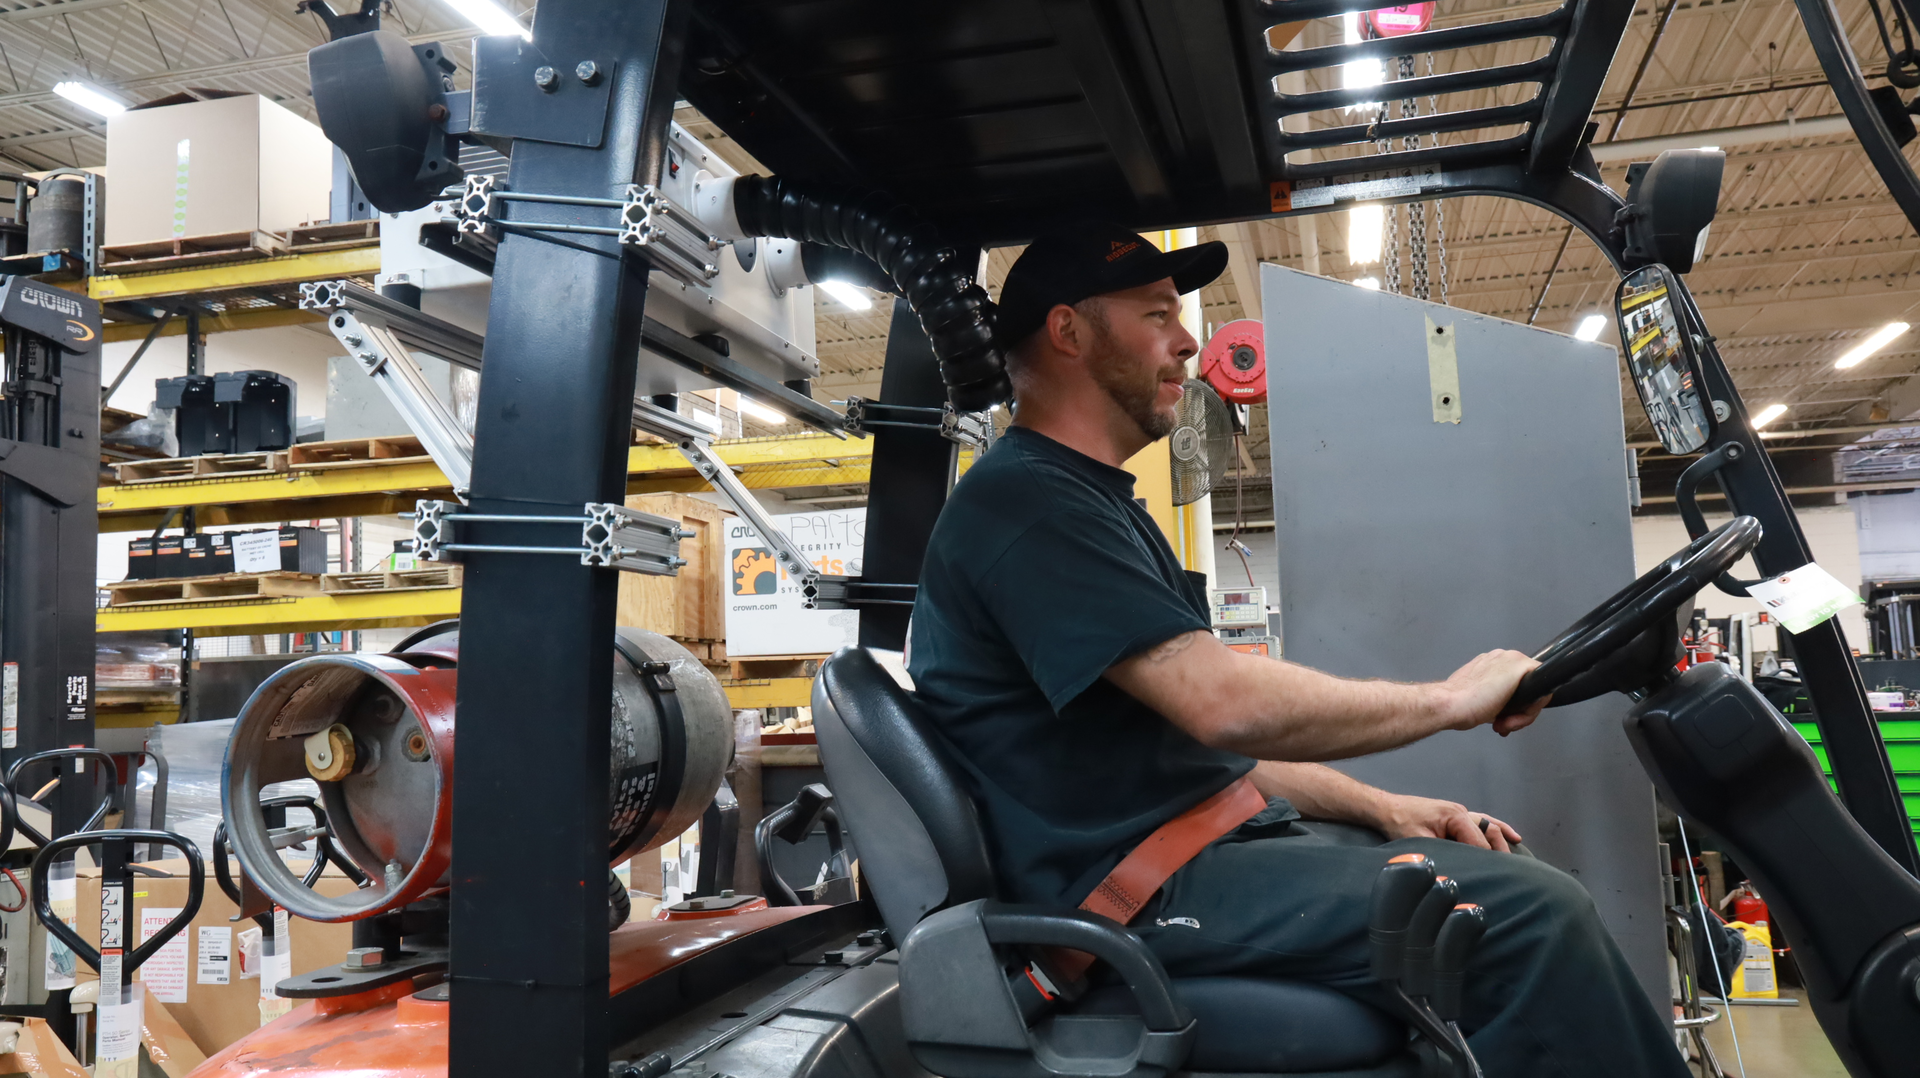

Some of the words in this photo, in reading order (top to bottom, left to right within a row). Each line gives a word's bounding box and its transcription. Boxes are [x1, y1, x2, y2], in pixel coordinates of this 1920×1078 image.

[20, 286, 82, 318] CROWN
[66, 325, 84, 336] RR
[800, 542, 842, 552] EGRITY
[1820, 607, 1831, 615] TO
